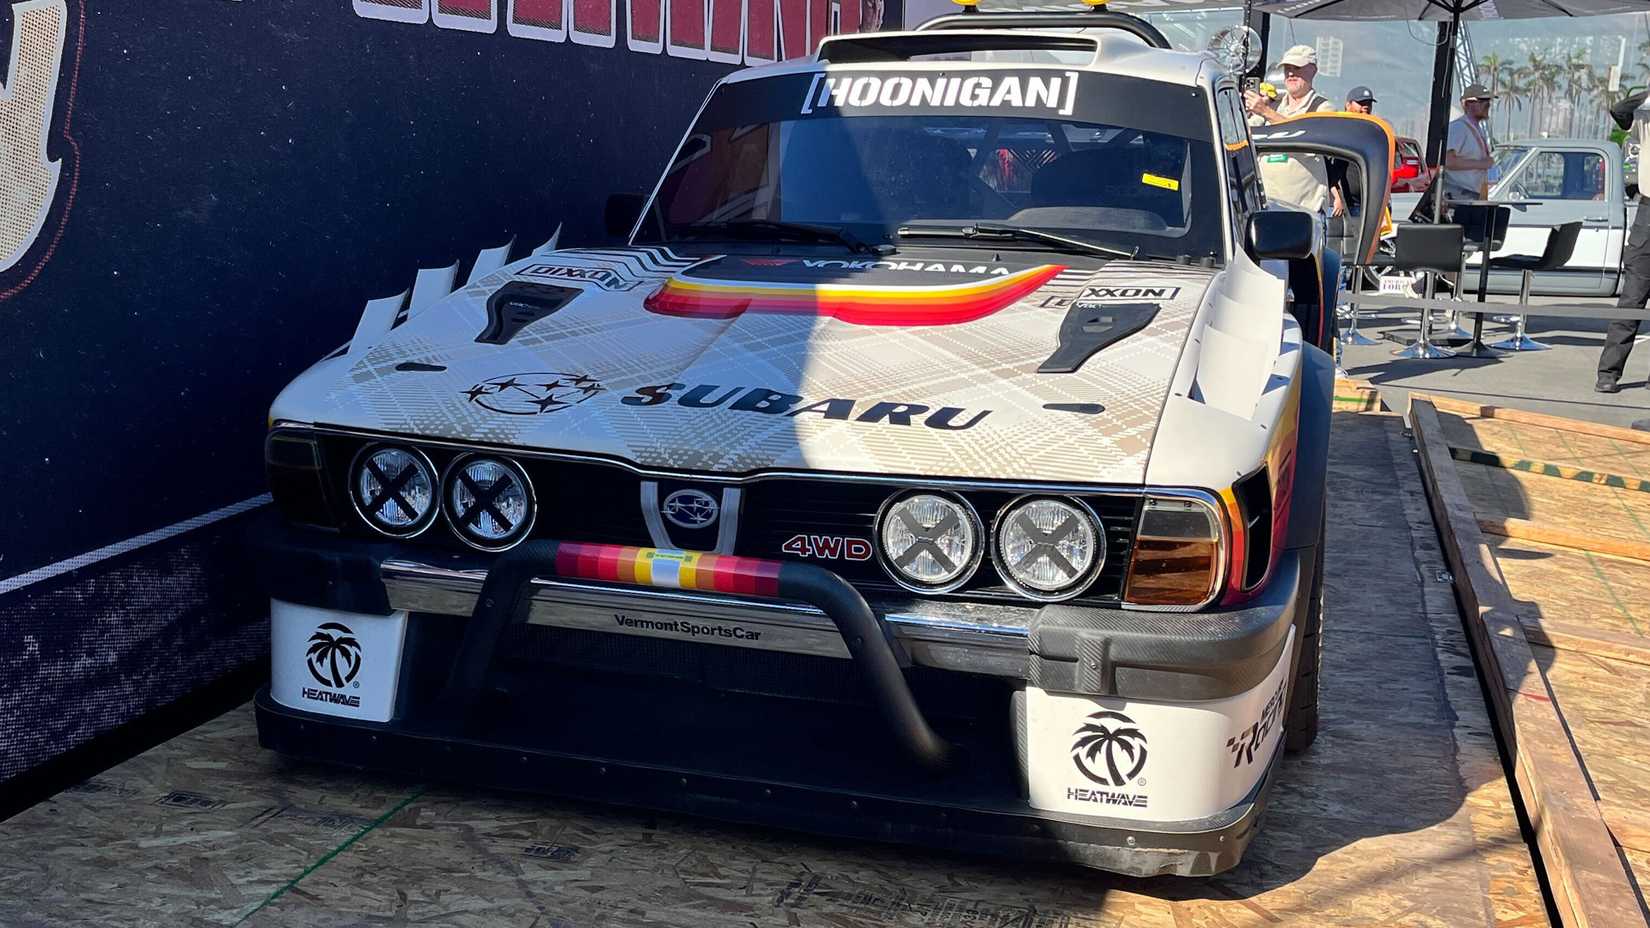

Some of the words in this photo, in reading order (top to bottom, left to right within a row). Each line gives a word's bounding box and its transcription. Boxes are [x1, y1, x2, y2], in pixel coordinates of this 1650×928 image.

[533, 265, 630, 290] DIXXON
[621, 382, 992, 431] SUBARU
[782, 534, 873, 561] 4WD
[614, 614, 761, 641] VermontSportsCar
[302, 687, 361, 708] HEATWAVE
[1067, 787, 1148, 807] HEATWAVE
